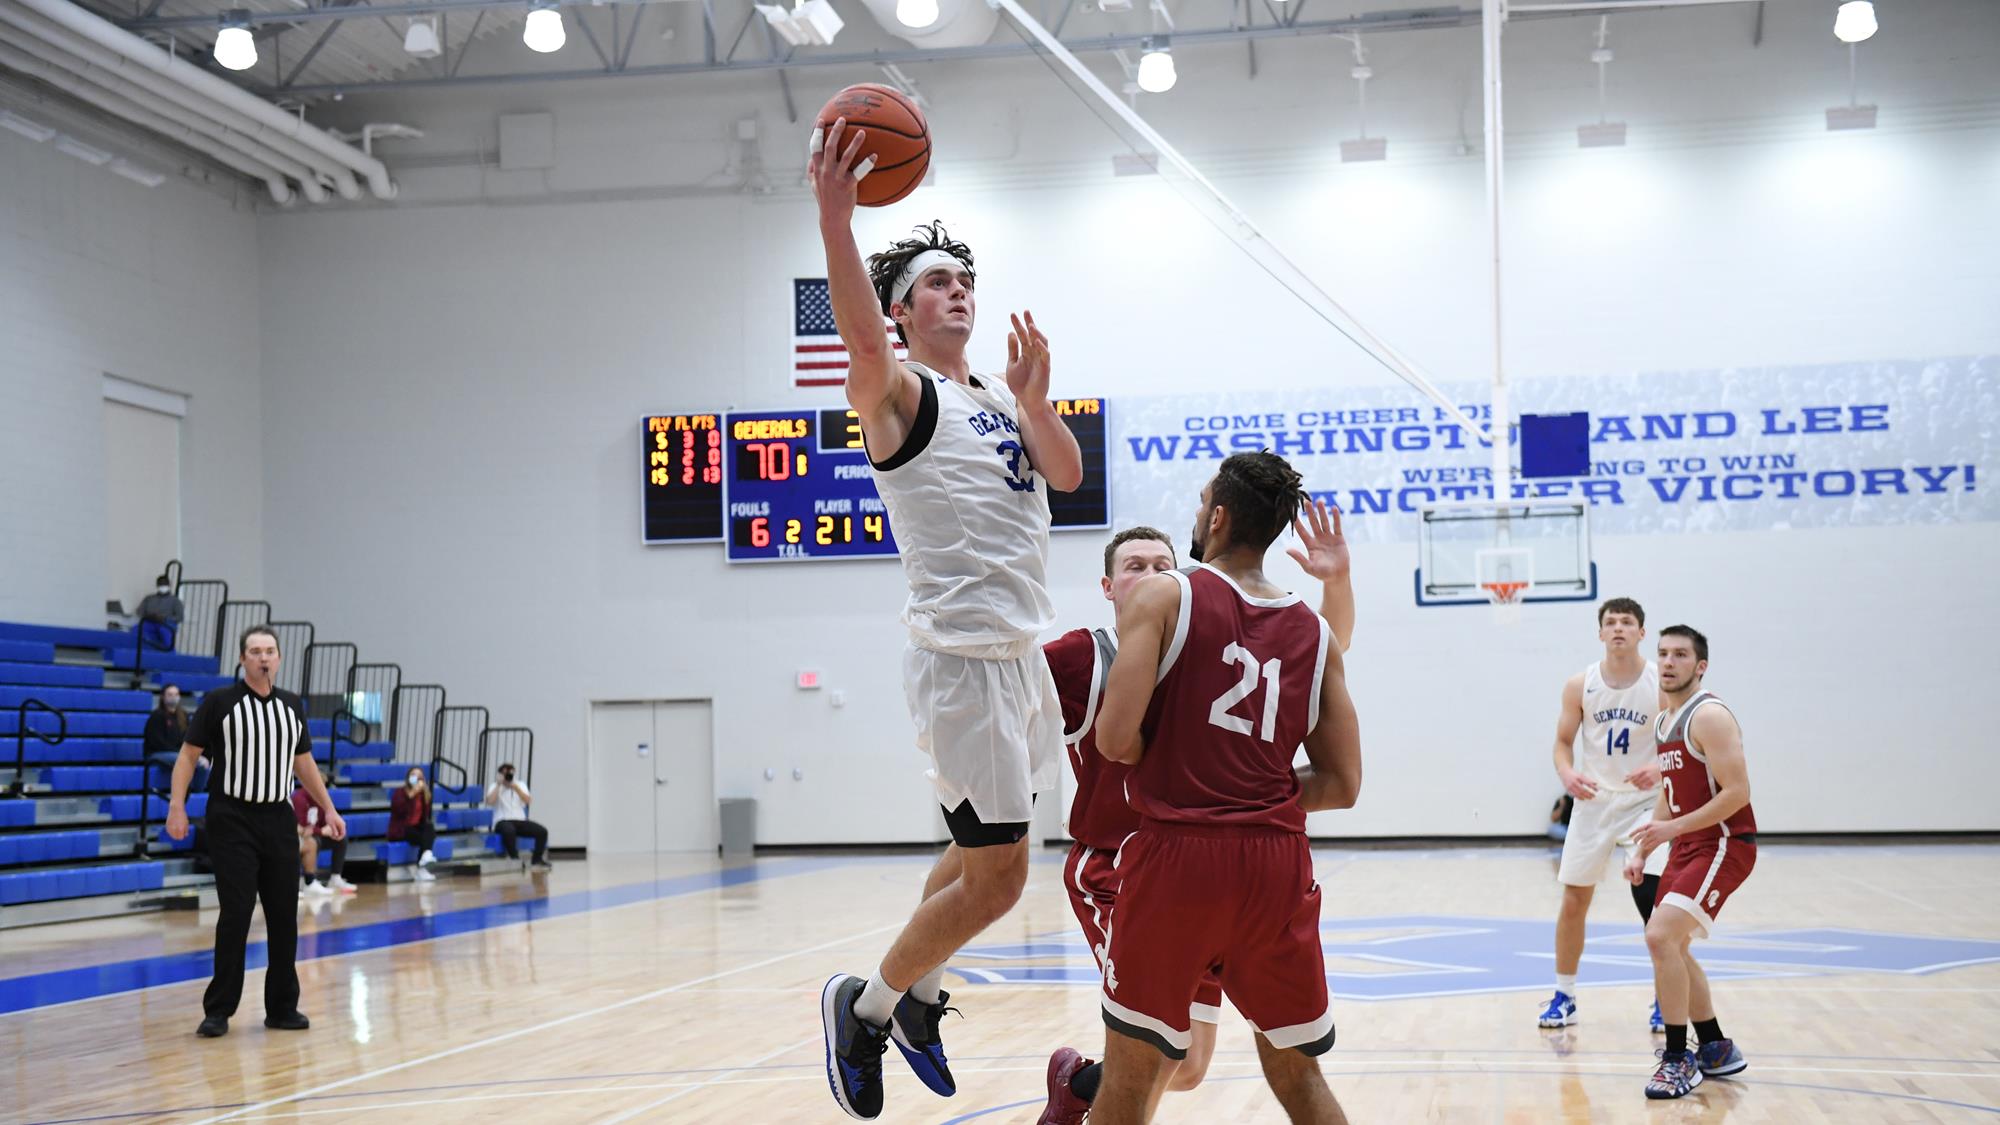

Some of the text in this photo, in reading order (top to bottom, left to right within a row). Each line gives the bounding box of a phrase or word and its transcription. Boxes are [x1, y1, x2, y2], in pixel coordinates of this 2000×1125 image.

[1074, 399, 1100, 415] PTS
[1185, 413, 1285, 431] COME
[1297, 407, 1426, 427] CHEER
[692, 415, 717, 430] PTS
[734, 419, 808, 441] GENERALS
[1127, 404, 1889, 461] WASHINGT AND LEE
[655, 430, 721, 450] 5 3 0
[682, 448, 695, 466] 2
[708, 447, 721, 466] 0
[746, 442, 790, 480] 70
[1403, 465, 1517, 483] WE'R
[1658, 457, 1706, 473] TO
[1721, 454, 1797, 471] WIN
[651, 465, 721, 485] 15 2 13
[834, 464, 873, 479] PERIO
[1648, 465, 1976, 503] VICTORY!
[731, 501, 770, 517] FOULS
[815, 498, 852, 513] PLAYER
[751, 518, 770, 547] 6
[785, 519, 801, 543] 2
[864, 515, 883, 541] 4
[1208, 641, 1281, 743] 21
[1593, 707, 1648, 726] GENERALS
[1607, 728, 1630, 755] 14
[1663, 776, 1681, 813] 2
